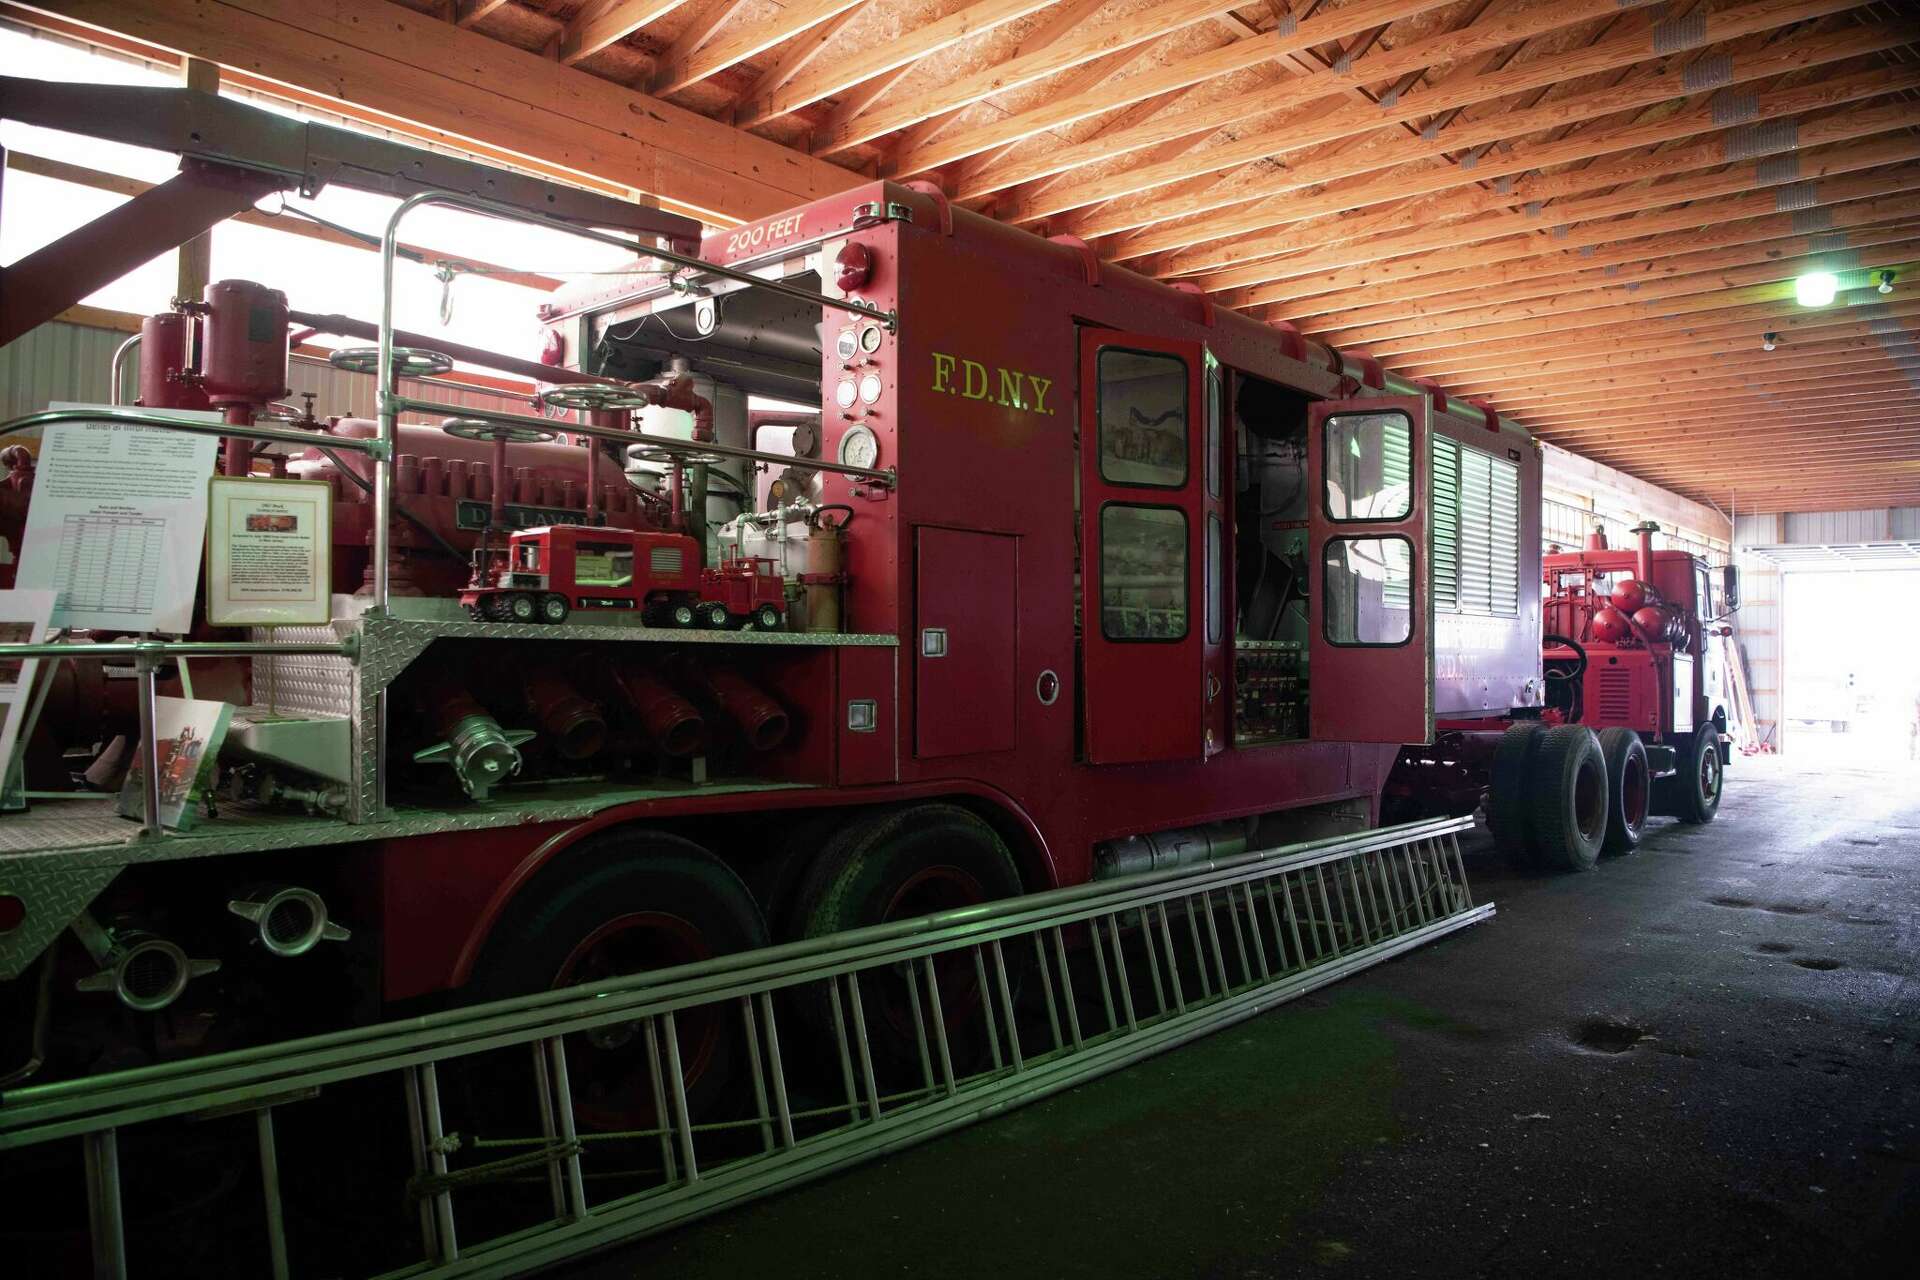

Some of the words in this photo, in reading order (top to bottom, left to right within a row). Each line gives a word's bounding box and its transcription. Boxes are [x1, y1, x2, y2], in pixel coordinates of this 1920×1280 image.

[726, 226, 764, 253] 200
[766, 213, 804, 241] FEET
[931, 352, 1055, 416] F.D.N.Y.
